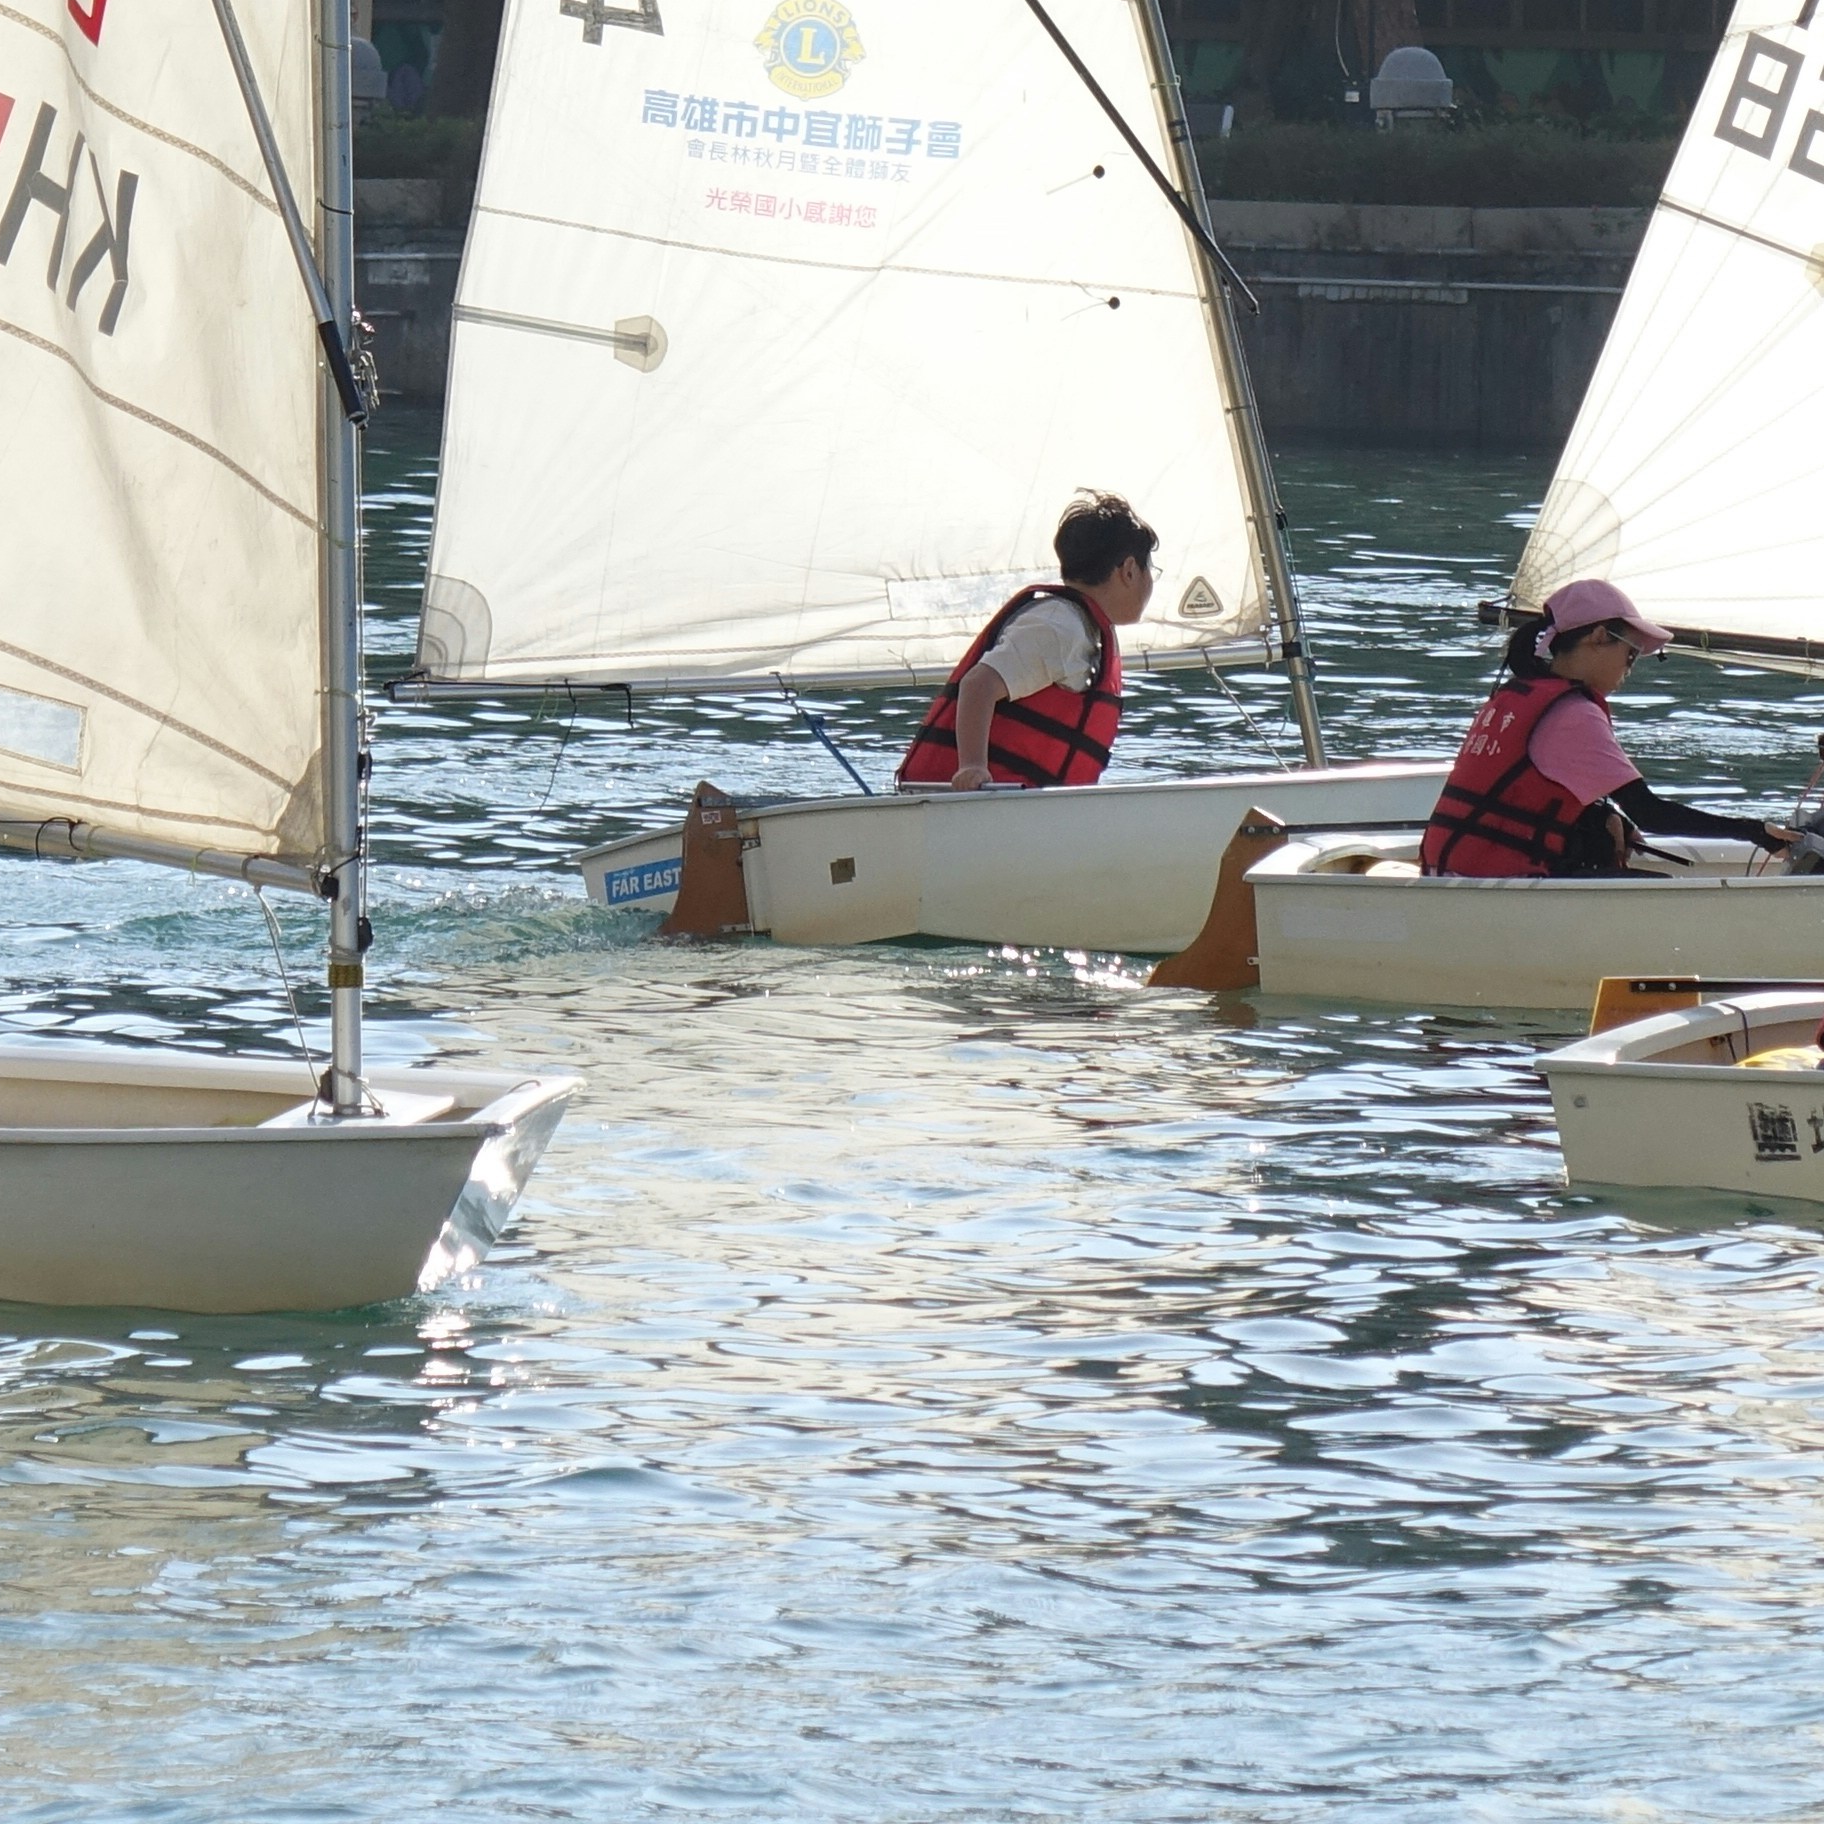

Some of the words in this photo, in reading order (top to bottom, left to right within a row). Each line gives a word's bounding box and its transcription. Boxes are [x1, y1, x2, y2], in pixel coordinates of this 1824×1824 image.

[797, 27, 826, 65] L
[642, 89, 962, 159] 高雄市中宜獅子會
[705, 187, 877, 229] 光榮國小感謝您
[612, 876, 640, 898] FAR
[643, 867, 682, 891] EAST
